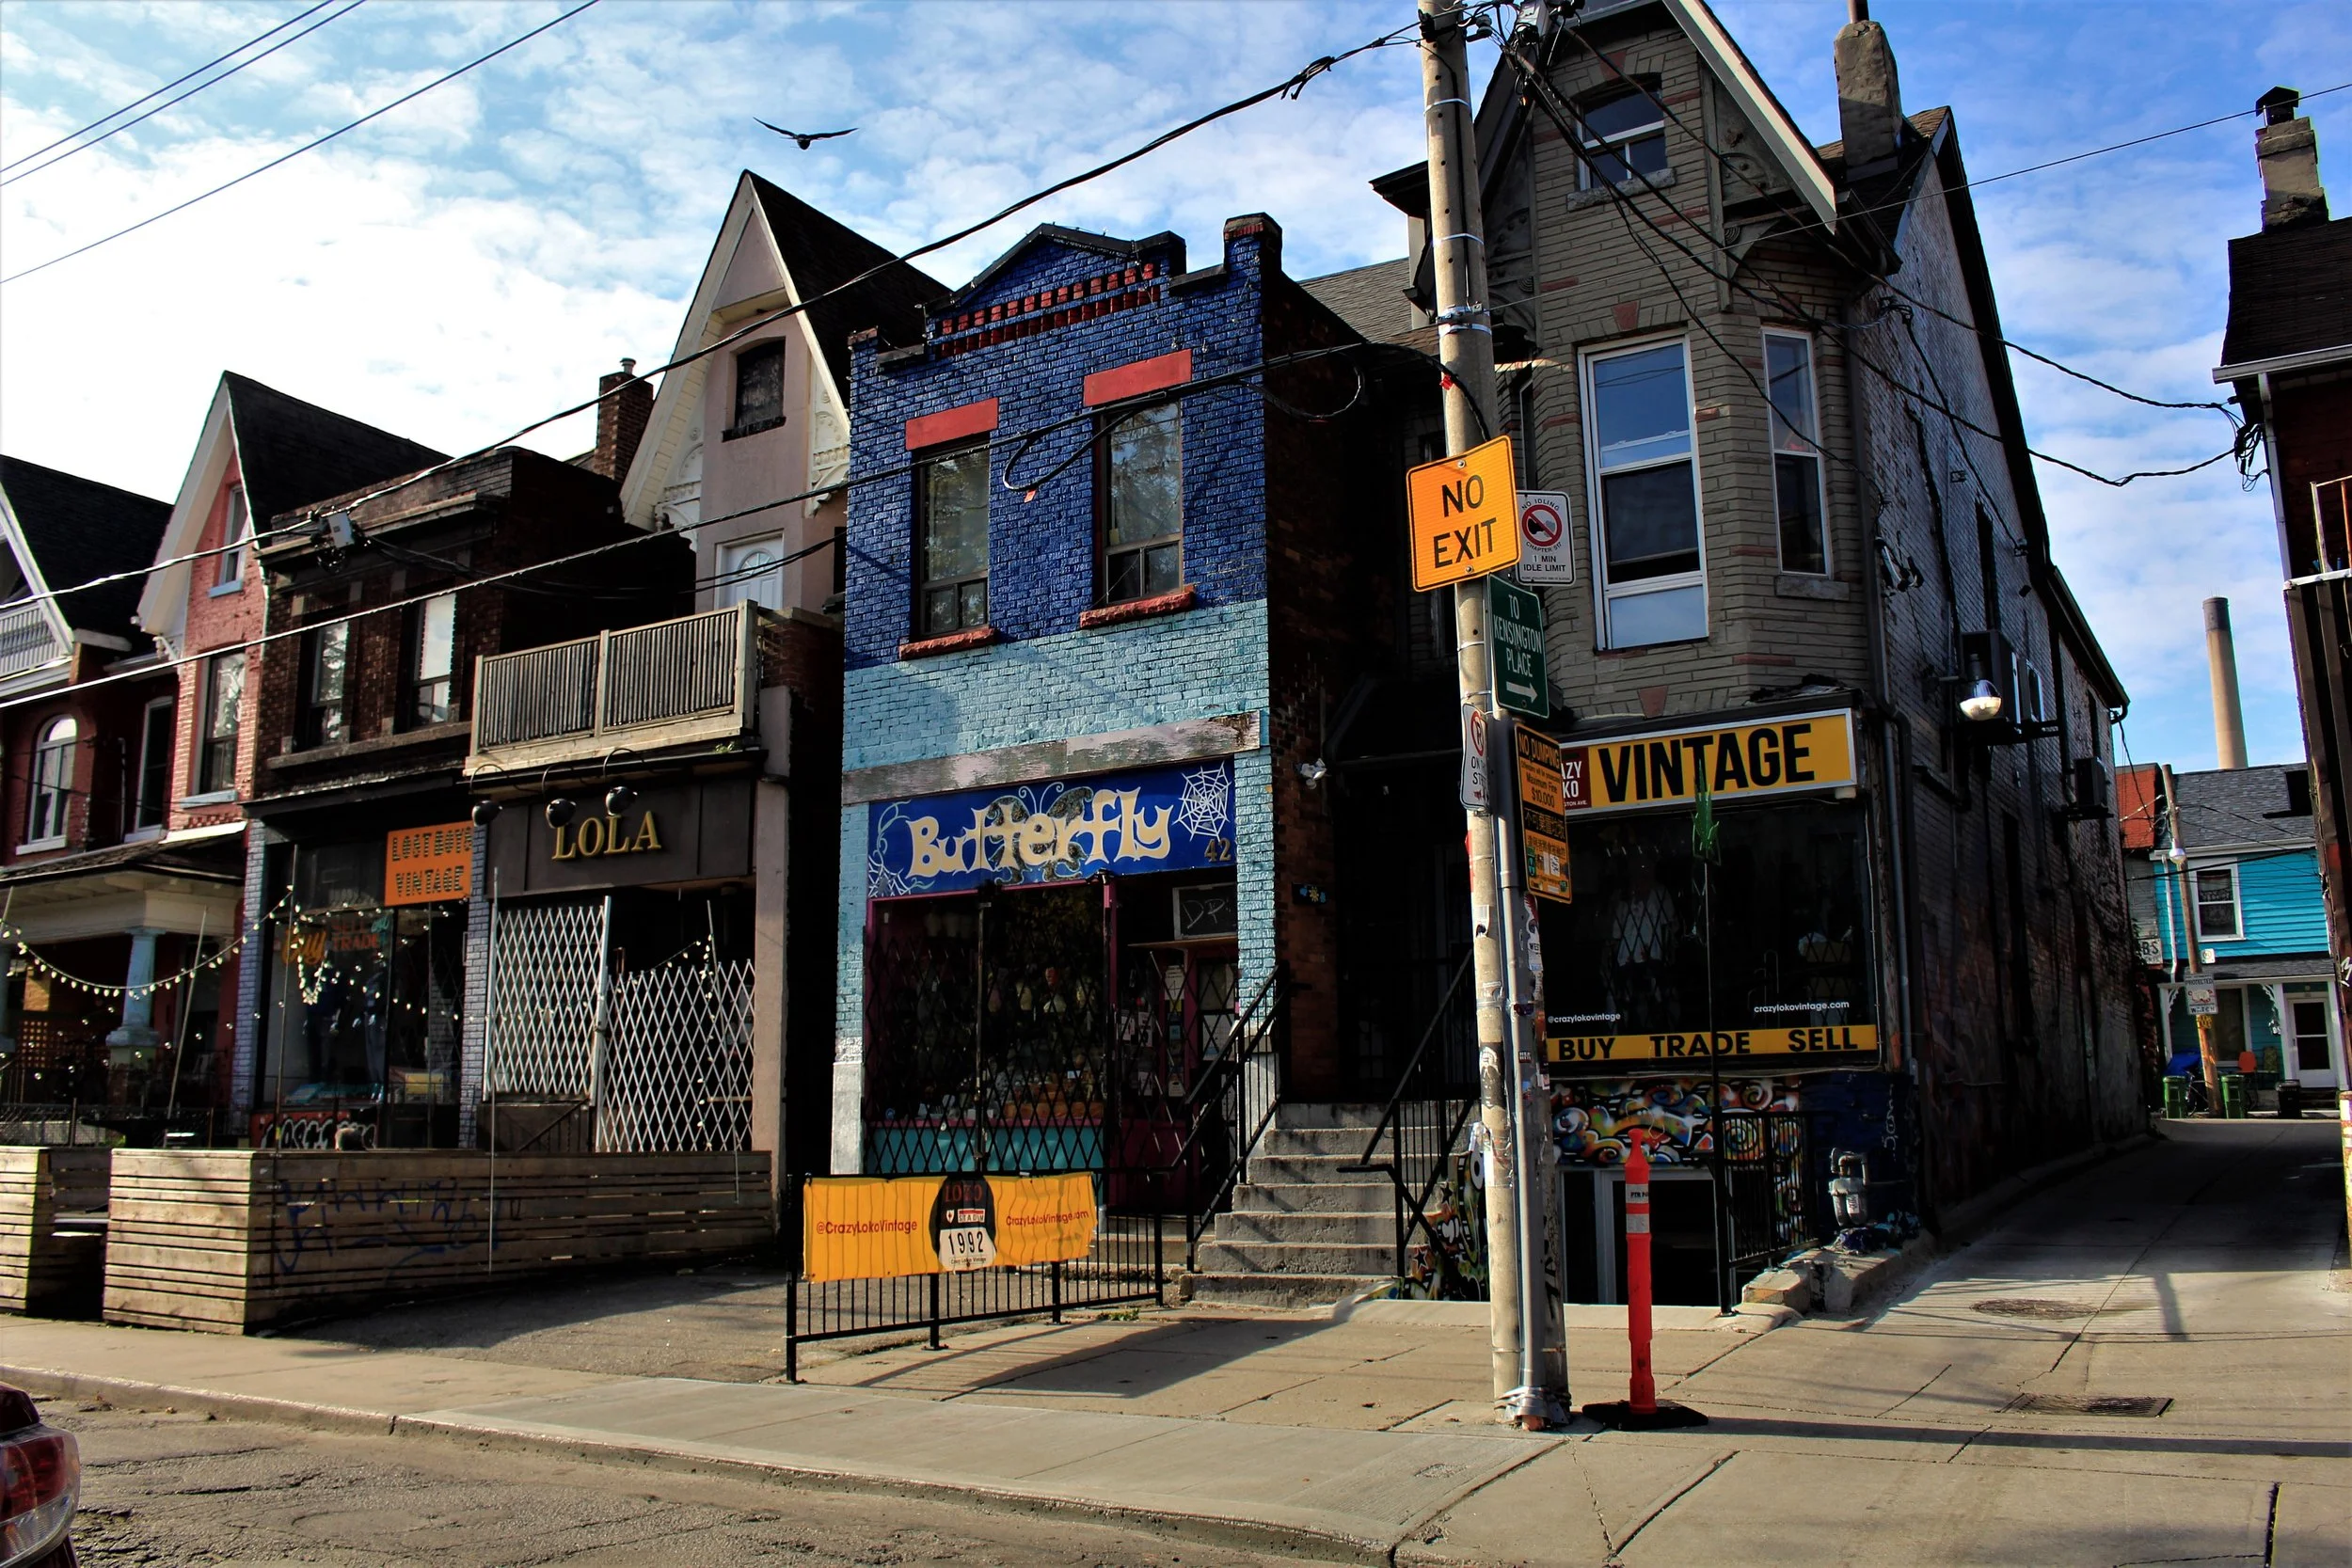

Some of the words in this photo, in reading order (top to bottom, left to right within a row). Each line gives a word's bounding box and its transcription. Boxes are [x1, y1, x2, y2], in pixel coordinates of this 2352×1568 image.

[1442, 475, 1484, 517] NO
[1521, 501, 1532, 511] NO
[1534, 499, 1560, 511] IDLING
[1434, 517, 1497, 568] EXIT
[1526, 542, 1552, 553] CHAPTER
[1508, 594, 1519, 620] TO
[1493, 613, 1542, 655] KENSINGTON
[1505, 647, 1534, 678] PLACE
[1518, 731, 1530, 756] NO
[1531, 737, 1561, 769] DUMPING
[1597, 723, 1815, 803] VINTAGE
[392, 832, 433, 863] LOST
[434, 826, 473, 856] BOYS
[551, 810, 662, 862] LOLA
[905, 786, 1174, 879] Butterfly
[1204, 837, 1232, 863] 42
[395, 865, 465, 897] VINTAGE
[330, 932, 379, 952] TRADE
[1548, 1013, 1621, 1023] @crazylokovintage
[1754, 1001, 1850, 1013] crazylokovintage.com
[1558, 1037, 1616, 1061] BUY
[1649, 1031, 1751, 1058] TRADE
[1787, 1027, 1859, 1053] SELL
[816, 1219, 917, 1236] @CrazyLokoVintage
[948, 1231, 984, 1255] 1992
